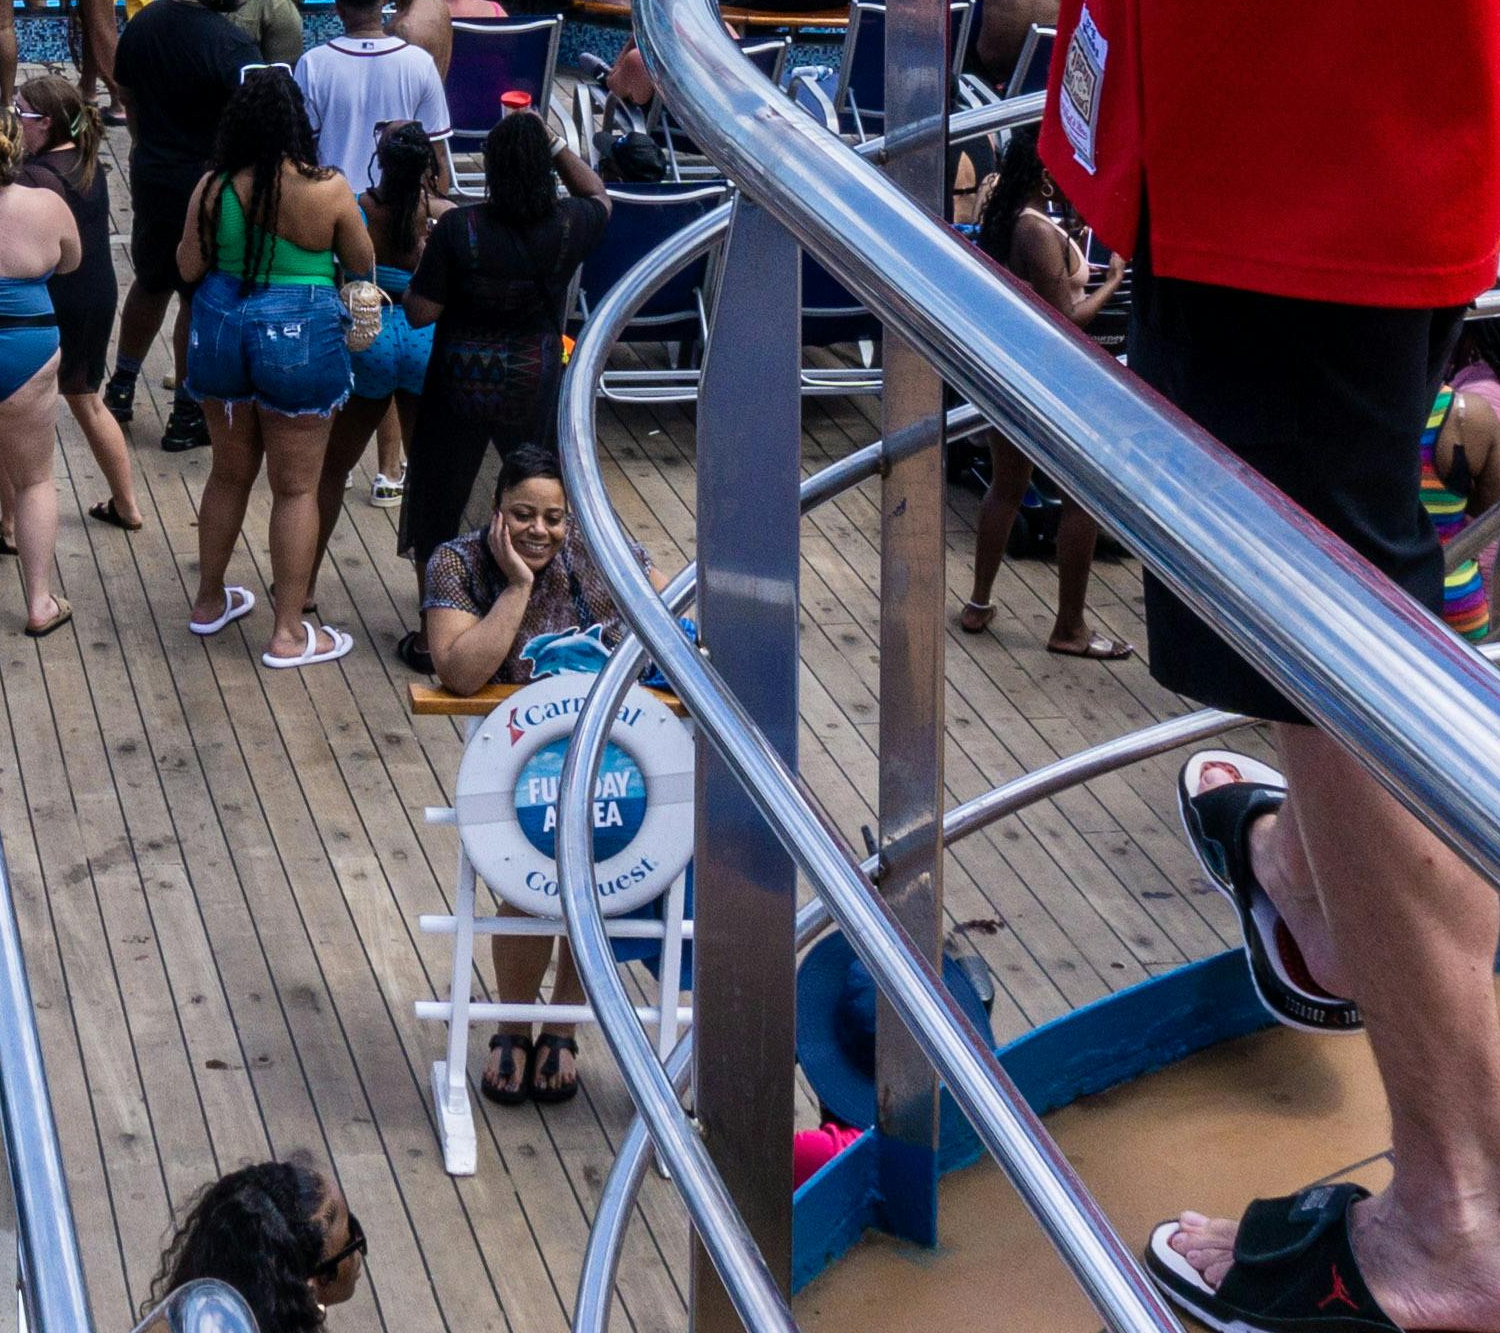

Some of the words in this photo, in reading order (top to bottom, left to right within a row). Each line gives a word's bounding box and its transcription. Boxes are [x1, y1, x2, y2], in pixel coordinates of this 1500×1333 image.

[525, 696, 642, 727] Carnal
[543, 800, 623, 833] AEA
[525, 854, 657, 897] Couest
